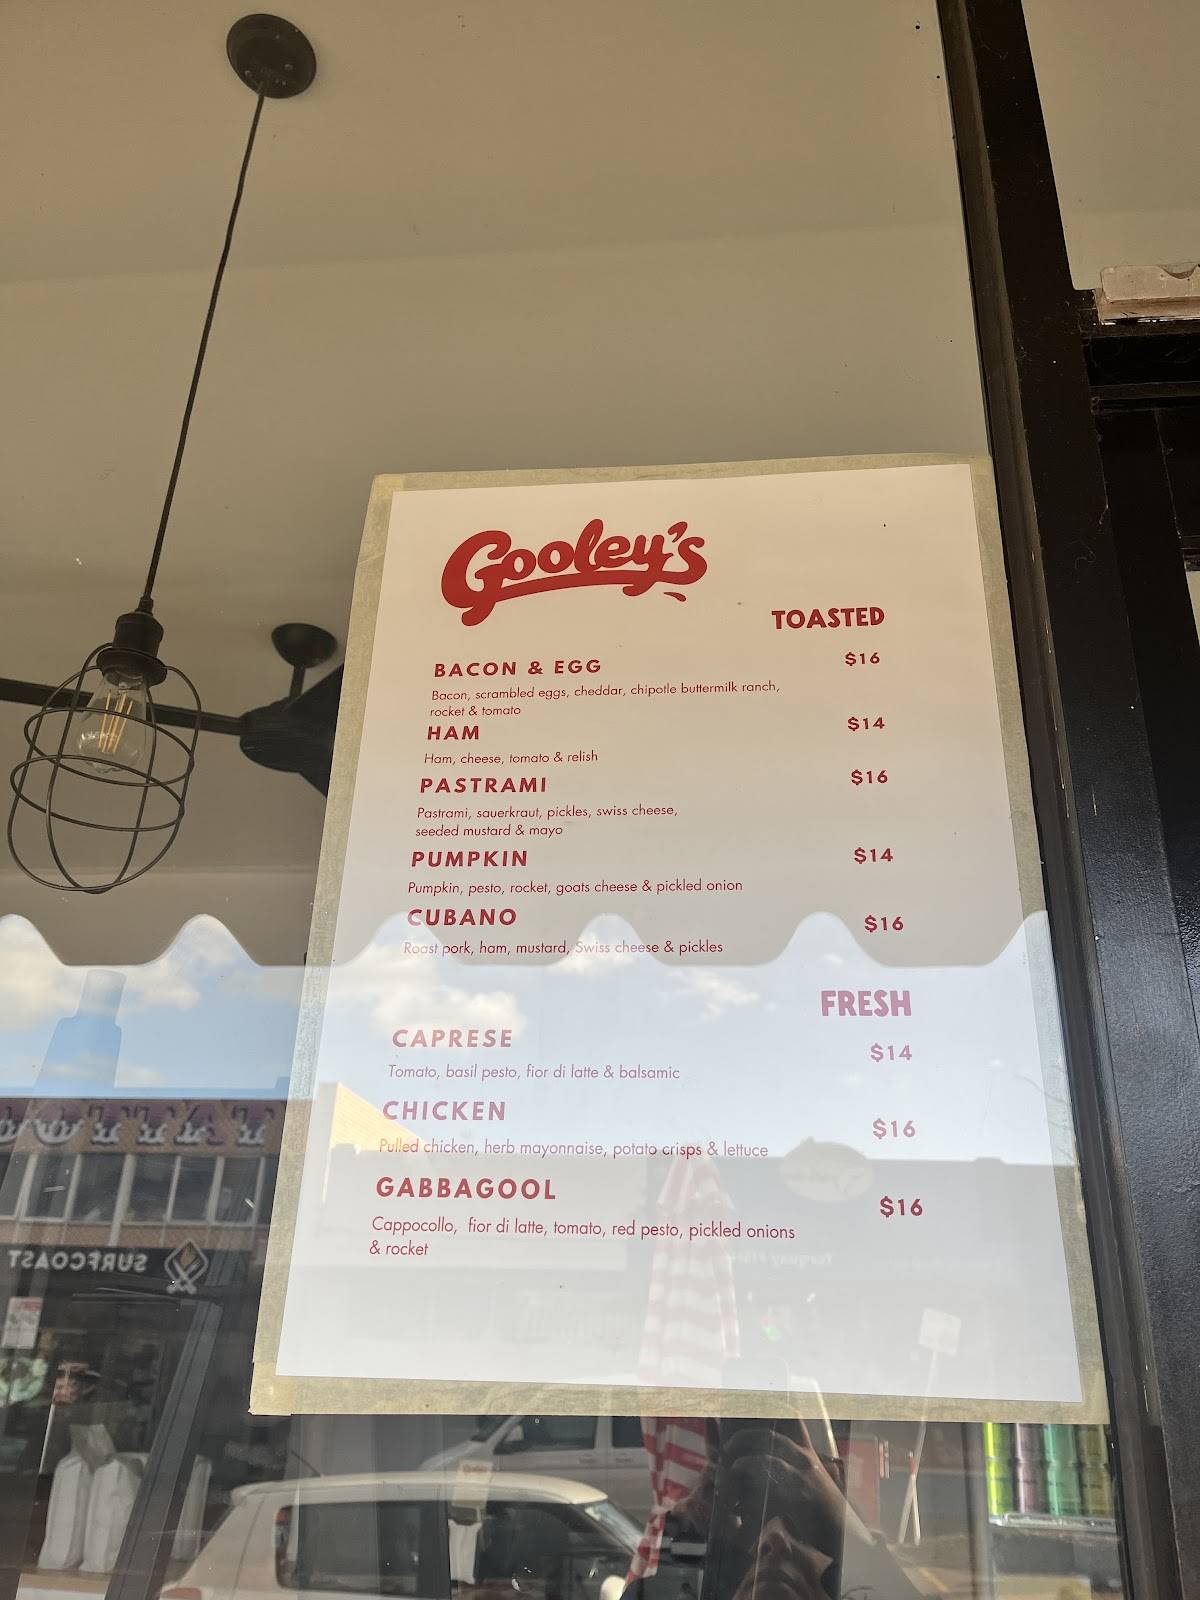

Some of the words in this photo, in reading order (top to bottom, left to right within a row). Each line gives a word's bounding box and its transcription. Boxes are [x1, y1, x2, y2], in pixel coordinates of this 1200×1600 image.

[441, 519, 708, 627] Gooley's
[772, 607, 885, 629] TOASTED
[845, 652, 880, 666] $16
[435, 662, 516, 677] BACON
[528, 661, 543, 674] &
[555, 660, 600, 674] EGG
[432, 689, 470, 701] Bacon,
[476, 687, 534, 699] scrambled
[539, 690, 569, 700] eggs,
[575, 685, 625, 696] cheddar,
[631, 683, 676, 696] chipotle
[682, 681, 737, 693] buttermilk
[743, 680, 779, 692] ranch,
[431, 706, 464, 716] rocket
[469, 706, 477, 716] &
[482, 706, 520, 715] tomato
[428, 726, 479, 740] HAM
[848, 717, 885, 731] $14
[425, 753, 455, 765] Ham,
[461, 753, 503, 764] cheese,
[510, 754, 549, 763] tomato
[554, 752, 563, 762] &
[568, 750, 597, 761] relish
[420, 777, 546, 793] PASTRAMI
[851, 769, 888, 785] $16
[418, 808, 471, 819] Pastrami,
[477, 806, 541, 819] sauerkraut,
[548, 805, 591, 820] pickles,
[597, 806, 627, 816] swiss
[632, 804, 677, 816] cheese,
[416, 825, 458, 836] seeded
[464, 824, 511, 836] mustard
[515, 825, 524, 835] &
[530, 827, 562, 838] mayo
[412, 851, 527, 867] PUMPKIN
[854, 847, 893, 864] $14
[409, 882, 462, 896] Pumpkin,
[469, 884, 504, 896] pesto,
[511, 881, 550, 894] rocket,
[556, 883, 590, 896] goats
[595, 880, 637, 892] cheese
[642, 880, 652, 891] &
[657, 878, 701, 895] pickled
[707, 880, 742, 890] onion
[408, 909, 516, 926] CUBANO
[865, 915, 903, 933] $16
[404, 941, 438, 954] Roast
[441, 941, 474, 957] pork,
[480, 940, 510, 955] ham,
[517, 940, 569, 955] mustard,
[576, 940, 609, 953] Swiss
[616, 941, 659, 953] cheese
[664, 940, 675, 953] &
[680, 939, 723, 956] pickles
[821, 990, 911, 1017] FRESH
[392, 1029, 512, 1047] CAPRESE
[871, 1043, 912, 1062] $14
[389, 1065, 439, 1079] Tomato,
[446, 1064, 477, 1077] basil
[482, 1067, 520, 1082] pesto,
[527, 1064, 549, 1079] fior
[553, 1064, 565, 1078] di
[571, 1064, 598, 1078] latte
[604, 1065, 614, 1078] &
[620, 1064, 680, 1078] balsamic
[383, 1101, 505, 1120] CHICKEN
[873, 1118, 915, 1139] $16
[380, 1139, 418, 1152] Pulled
[424, 1138, 478, 1156] chicken,
[485, 1138, 515, 1153] herb
[521, 1141, 606, 1158] mayonnaise,
[614, 1143, 657, 1159] potato
[662, 1142, 703, 1160] crisps
[707, 1141, 718, 1155] &
[724, 1140, 768, 1156] lettuce
[376, 1177, 555, 1199] GABBAGOOL
[880, 1196, 923, 1218] $16
[372, 1216, 457, 1234] Cappocollo,
[469, 1217, 491, 1232] fior
[496, 1217, 509, 1233] di
[515, 1218, 547, 1236] latte,
[554, 1221, 605, 1237] tomato,
[613, 1220, 635, 1235] red
[641, 1224, 682, 1240] pesto,
[690, 1221, 740, 1240] pickled
[747, 1225, 795, 1238] onions
[370, 1240, 380, 1254] &
[386, 1240, 428, 1255] rocket
